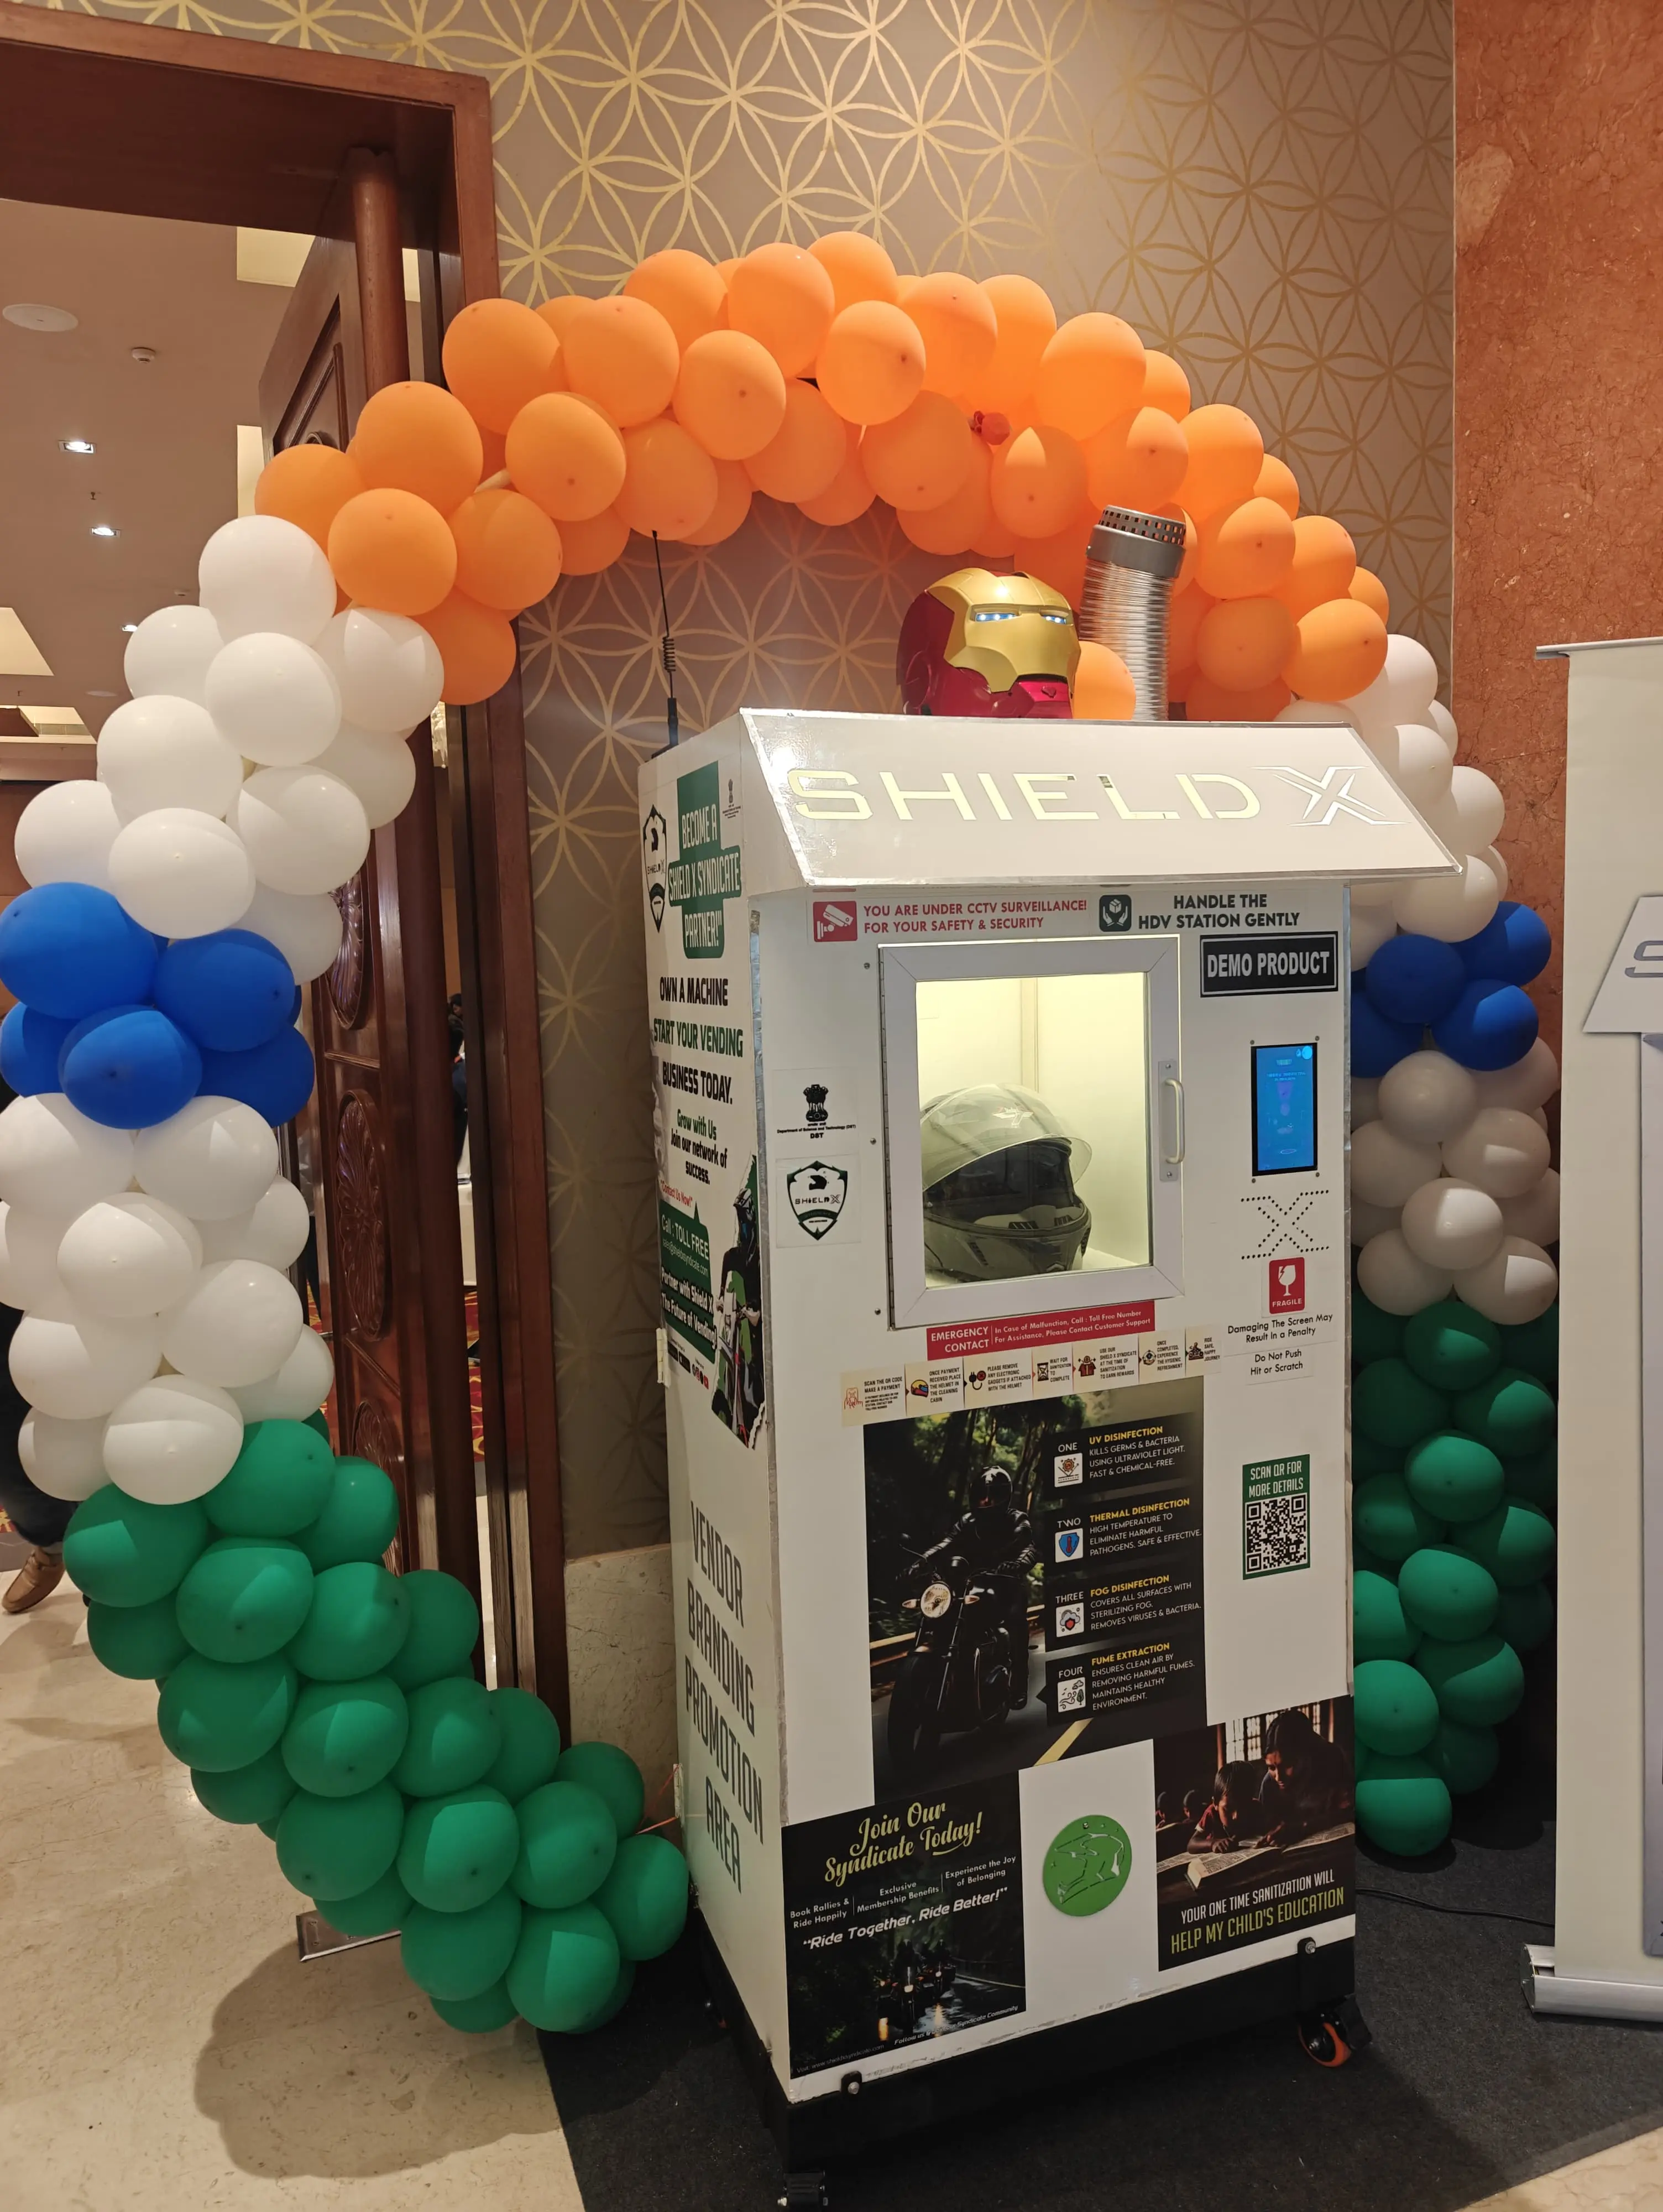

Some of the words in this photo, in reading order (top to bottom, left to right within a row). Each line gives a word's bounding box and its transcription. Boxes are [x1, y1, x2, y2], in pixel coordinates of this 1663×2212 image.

[682, 806, 710, 849] BECOME
[712, 804, 717, 840] A
[670, 864, 690, 901] SHIELD
[692, 862, 696, 897] X
[698, 852, 740, 896] SYNDICATE
[864, 905, 890, 916] YOU
[895, 904, 918, 916] ARE
[923, 904, 963, 915] UNDER
[968, 902, 997, 913] CCTV
[1001, 900, 1087, 912] SURVEILLANCE!
[1174, 895, 1236, 909] HANDLE
[1240, 894, 1267, 907] THE
[864, 922, 888, 933] FOR
[893, 921, 928, 932] YOUR
[932, 919, 974, 931] SAFETY
[979, 920, 986, 930] &
[990, 917, 1043, 929] SECURITY
[1139, 915, 1171, 929] HDV
[1176, 914, 1240, 928] STATION
[1245, 912, 1300, 926] GENTLY
[1207, 953, 1252, 977] DEMO
[1257, 951, 1330, 975] PRODUCT
[660, 977, 677, 1002] OWN
[679, 978, 685, 1003] A
[687, 978, 728, 1006] MACHINE
[653, 1018, 674, 1045] START
[677, 1021, 698, 1049] YOUR
[700, 1025, 743, 1057] VENDING
[663, 1061, 698, 1094] BUSINESS
[700, 1070, 733, 1104] TODAY.
[677, 1109, 692, 1131] Grow
[693, 1115, 707, 1137] with
[708, 1119, 717, 1140] Us
[671, 1128, 681, 1149] Join
[682, 1138, 691, 1152] our
[693, 1141, 718, 1165] network
[720, 1147, 728, 1168] of
[686, 1160, 710, 1185] success.
[1272, 1298, 1302, 1307] FRAGILE
[931, 1327, 989, 1342] EMERGENCY
[1007, 1332, 1044, 1342] Assistance,
[1046, 1329, 1067, 1337] Please
[1069, 1326, 1093, 1334] Contact
[1095, 1322, 1124, 1331] Customer
[1126, 1318, 1150, 1329] Support
[1228, 1323, 1268, 1334] Damaging
[1272, 1319, 1285, 1328] The
[1288, 1316, 1313, 1326] Screen
[1246, 1333, 1268, 1343] Result
[1288, 1327, 1315, 1337] Penalty
[945, 1339, 989, 1353] CONTACT
[1285, 1349, 1301, 1358] Push
[1251, 1367, 1262, 1375] Hit
[1275, 1361, 1303, 1372] Scratch
[1089, 1436, 1101, 1444] UV
[1105, 1426, 1163, 1442] DISINFECTION
[1089, 1447, 1108, 1455] KILLS
[1111, 1442, 1136, 1453] GERMS
[1146, 1436, 1180, 1447] BACTERIA
[1058, 1442, 1078, 1452] ONE
[1089, 1458, 1112, 1467] USING
[1115, 1449, 1161, 1464] ULTRAVIOLET
[1163, 1446, 1185, 1455] LIGHT.
[1251, 1465, 1271, 1480] SCAN
[1274, 1463, 1284, 1477] QR
[1287, 1460, 1301, 1474] FOR
[1249, 1483, 1270, 1498] MORE
[1273, 1478, 1303, 1494] DETAILS
[1090, 1509, 1130, 1522] THERMAL
[1132, 1498, 1190, 1515] DISINFECTION
[1057, 1518, 1081, 1528] TWO
[1090, 1525, 1108, 1534] HIGH
[1111, 1515, 1160, 1531] TEMPERATURE
[1090, 1532, 1127, 1545] ELIMINATE
[1129, 1526, 1163, 1537] HARMFUL
[691, 1501, 744, 1628] VENDOR
[1090, 1587, 1110, 1597] FOG
[1111, 1575, 1169, 1593] DISINFECTION
[1090, 1597, 1120, 1608] COVERS
[1122, 1593, 1134, 1601] ALL
[1137, 1586, 1172, 1599] SURFACES
[1174, 1582, 1191, 1591] WITH
[1055, 1592, 1084, 1604] THREE
[1091, 1605, 1134, 1619] STERILIZING
[1136, 1601, 1153, 1610] FOG.
[687, 1577, 755, 1737] BRANDING
[1091, 1654, 1115, 1666] FUME
[1117, 1642, 1170, 1660] EXTRACTION
[1059, 1667, 1083, 1678] FOUR
[1092, 1674, 1132, 1688] REMOVING
[1134, 1667, 1168, 1679] HARMFUL
[1170, 1661, 1195, 1671] FUMES.
[1092, 1684, 1132, 1699] MAINTAINS
[1134, 1677, 1165, 1690] HEALTHY
[1093, 1693, 1147, 1710] ENVIRONMENT.
[685, 1654, 763, 1845] PROMOTION
[705, 1776, 741, 1895] AREA
[849, 1814, 900, 1856] Join
[907, 1802, 946, 1827] Our
[825, 1835, 914, 1887] Syndicate
[920, 1812, 982, 1856] Today!
[945, 1864, 986, 1879] Experience
[989, 1860, 1000, 1869] the
[1003, 1856, 1016, 1866] Joy
[957, 1878, 965, 1887] of
[968, 1869, 1006, 1885] Belonging
[880, 1881, 917, 1896] Exclusive
[1181, 1904, 1206, 1924] YOUR
[1209, 1900, 1227, 1917] ONE
[1230, 1893, 1250, 1910] TIME
[1252, 1877, 1311, 1906] SANITIZATION
[1315, 1868, 1334, 1887] WILL
[790, 1909, 810, 1918] Book
[813, 1900, 841, 1913] Rallies
[857, 1895, 906, 1913] Membership
[908, 1886, 939, 1900] Benefits
[793, 1918, 812, 1929] Ride
[814, 1910, 847, 1924] Happily
[849, 1915, 915, 1940] Together,
[919, 1905, 949, 1922] Ride
[1171, 1928, 1201, 1955] HELP
[1206, 1922, 1223, 1943] MY
[1227, 1907, 1274, 1937] CHILD'S
[1278, 1887, 1344, 1924] EDUCATION
